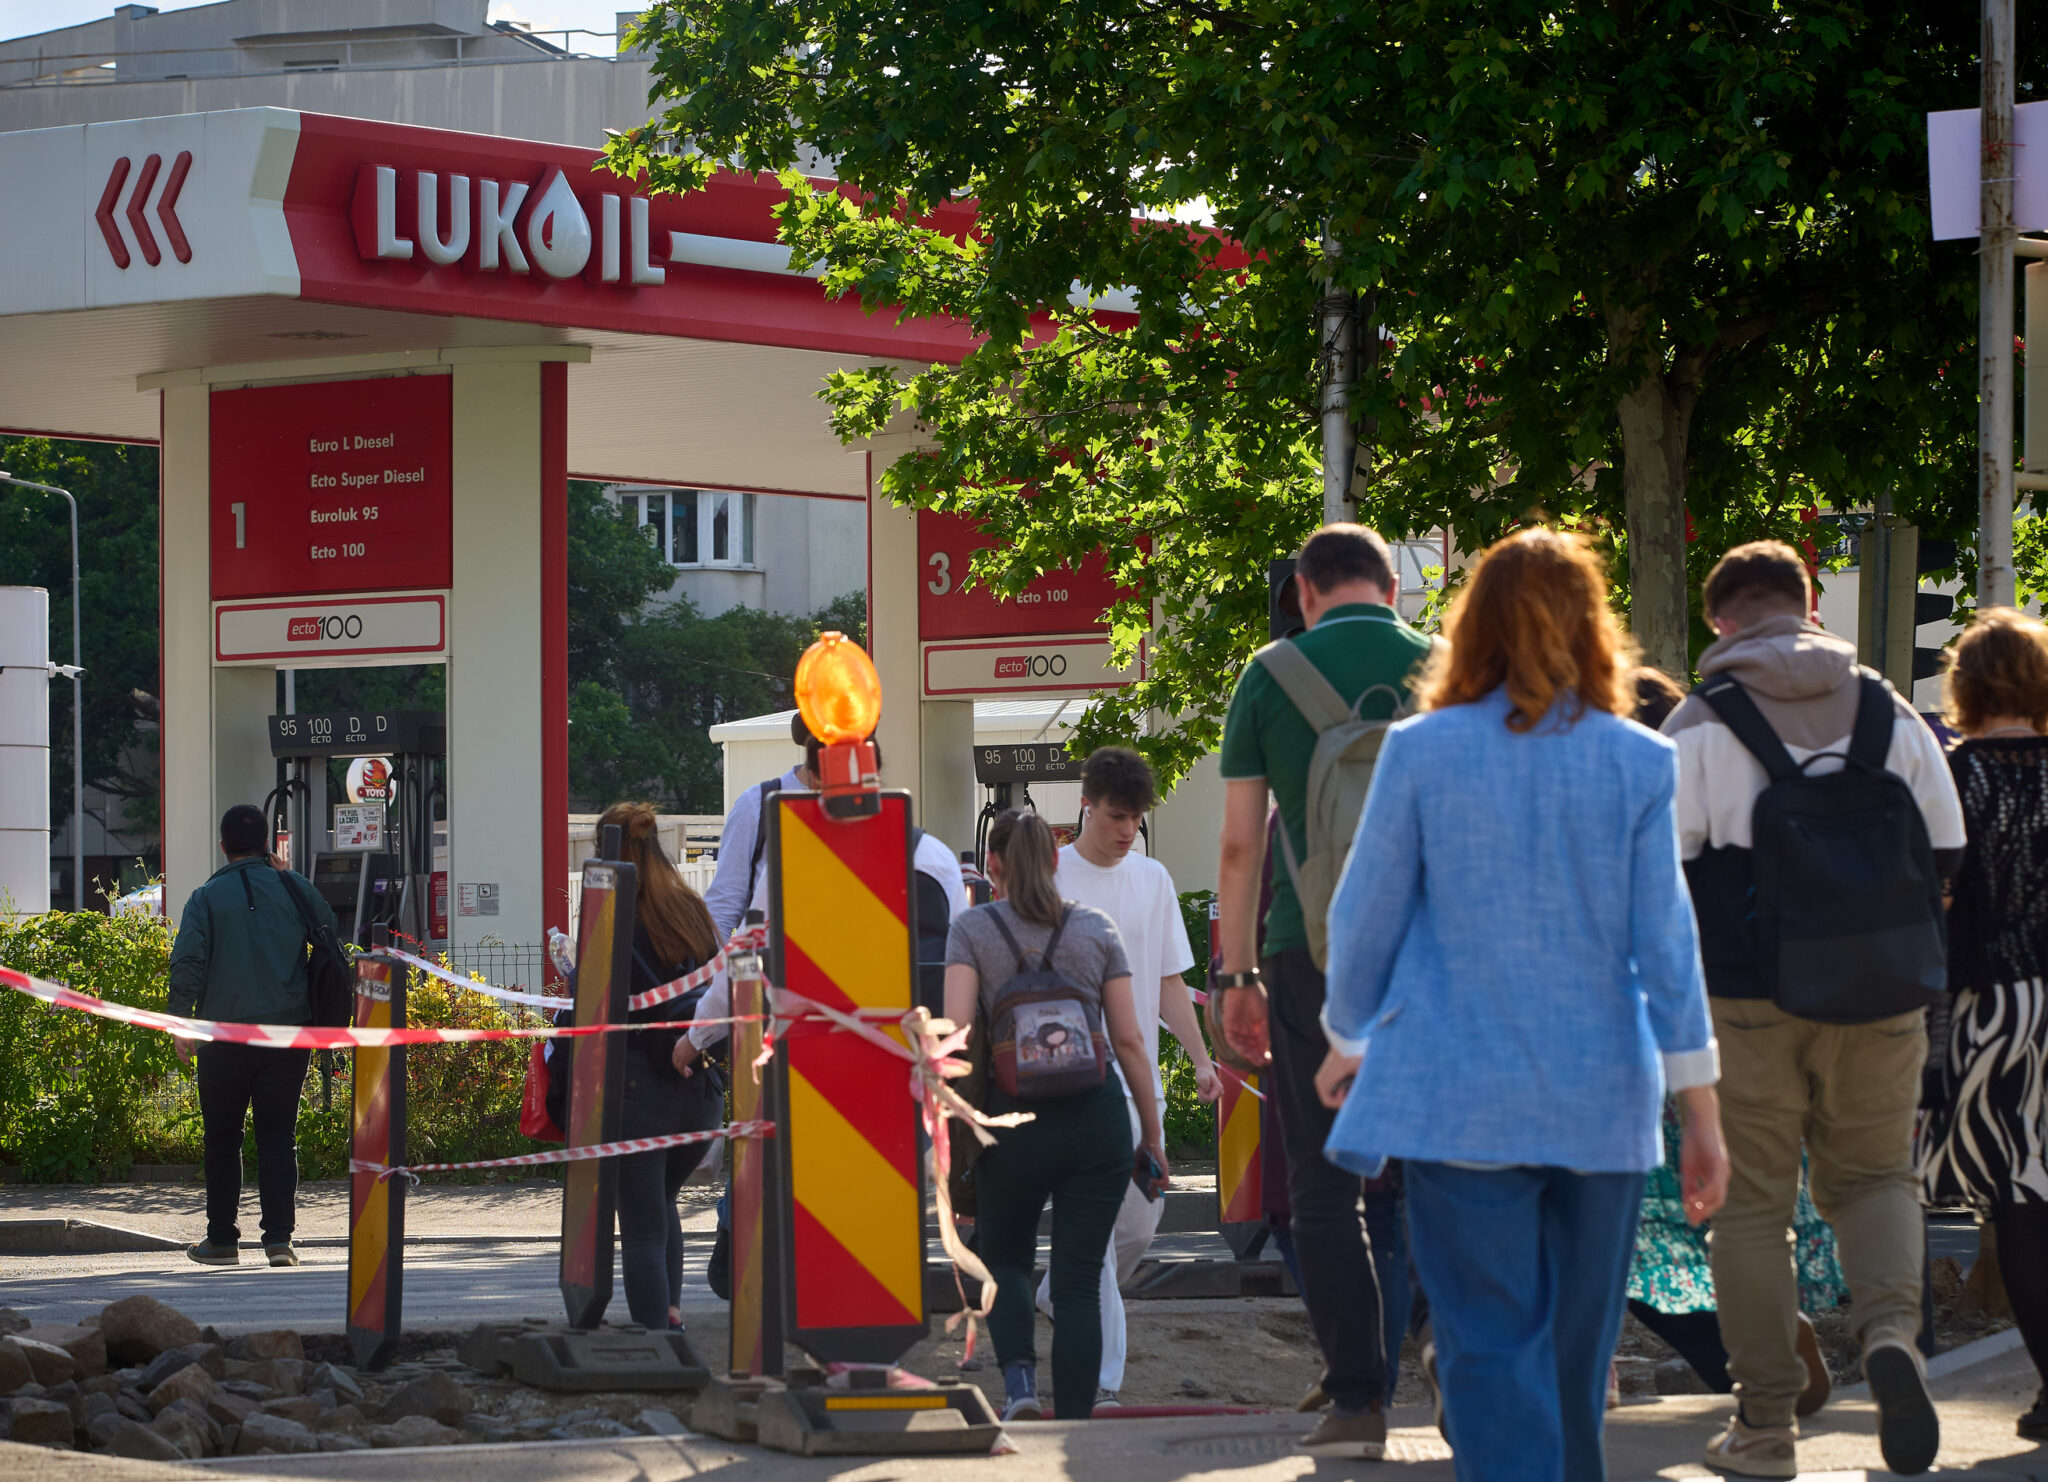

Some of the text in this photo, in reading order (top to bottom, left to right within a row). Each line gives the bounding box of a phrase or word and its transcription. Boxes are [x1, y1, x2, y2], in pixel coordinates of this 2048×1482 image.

[376, 166, 666, 285] LUKOIL
[310, 439, 339, 453] Euro
[343, 436, 350, 450] L
[311, 467, 425, 489] Ecto Super Diesel
[310, 506, 379, 523] Euroluk 95
[231, 502, 246, 549] 1
[311, 543, 366, 560] Ecto 100
[928, 551, 951, 596] 3
[1016, 589, 1069, 605] Ecto 100
[280, 715, 387, 736] 95 100 D D
[311, 734, 367, 744] ECTO ECTO
[984, 748, 1060, 764] 95 100 D
[1015, 762, 1066, 771] ECTO ECTO
[365, 788, 386, 798] YOYO
